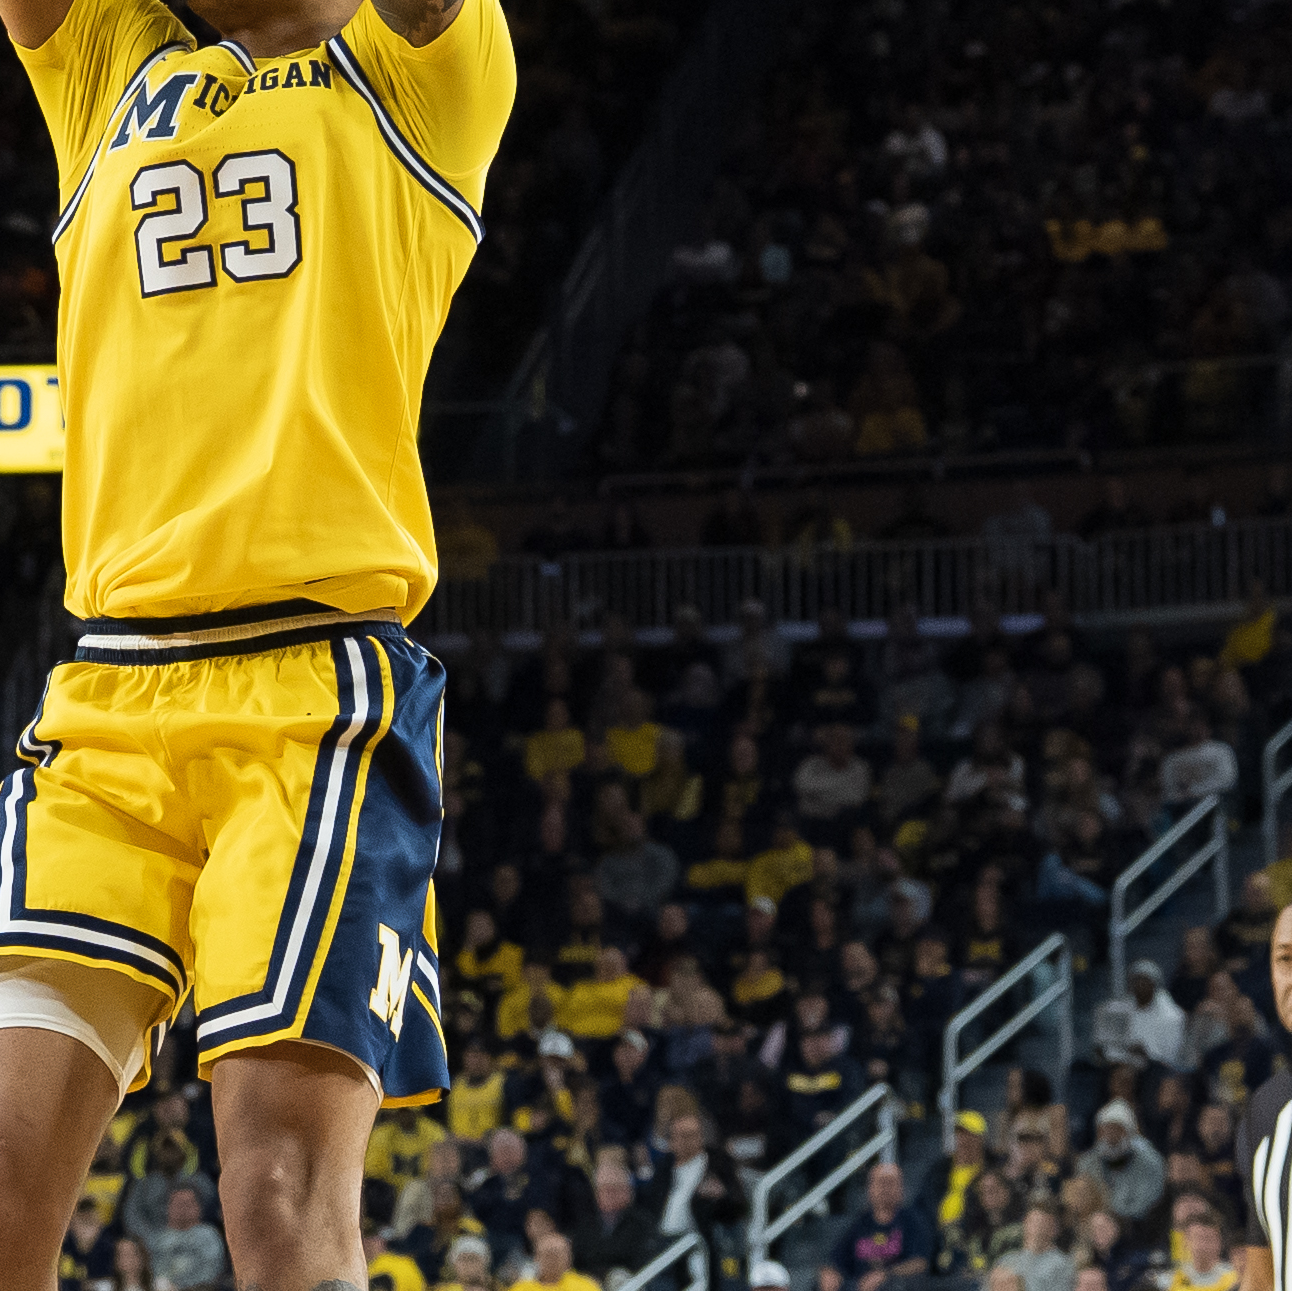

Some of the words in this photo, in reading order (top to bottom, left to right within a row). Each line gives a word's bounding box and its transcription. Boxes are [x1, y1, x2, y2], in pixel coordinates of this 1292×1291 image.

[108, 59, 332, 152] MICIGAN
[130, 149, 302, 299] 23
[369, 922, 413, 1043] M
